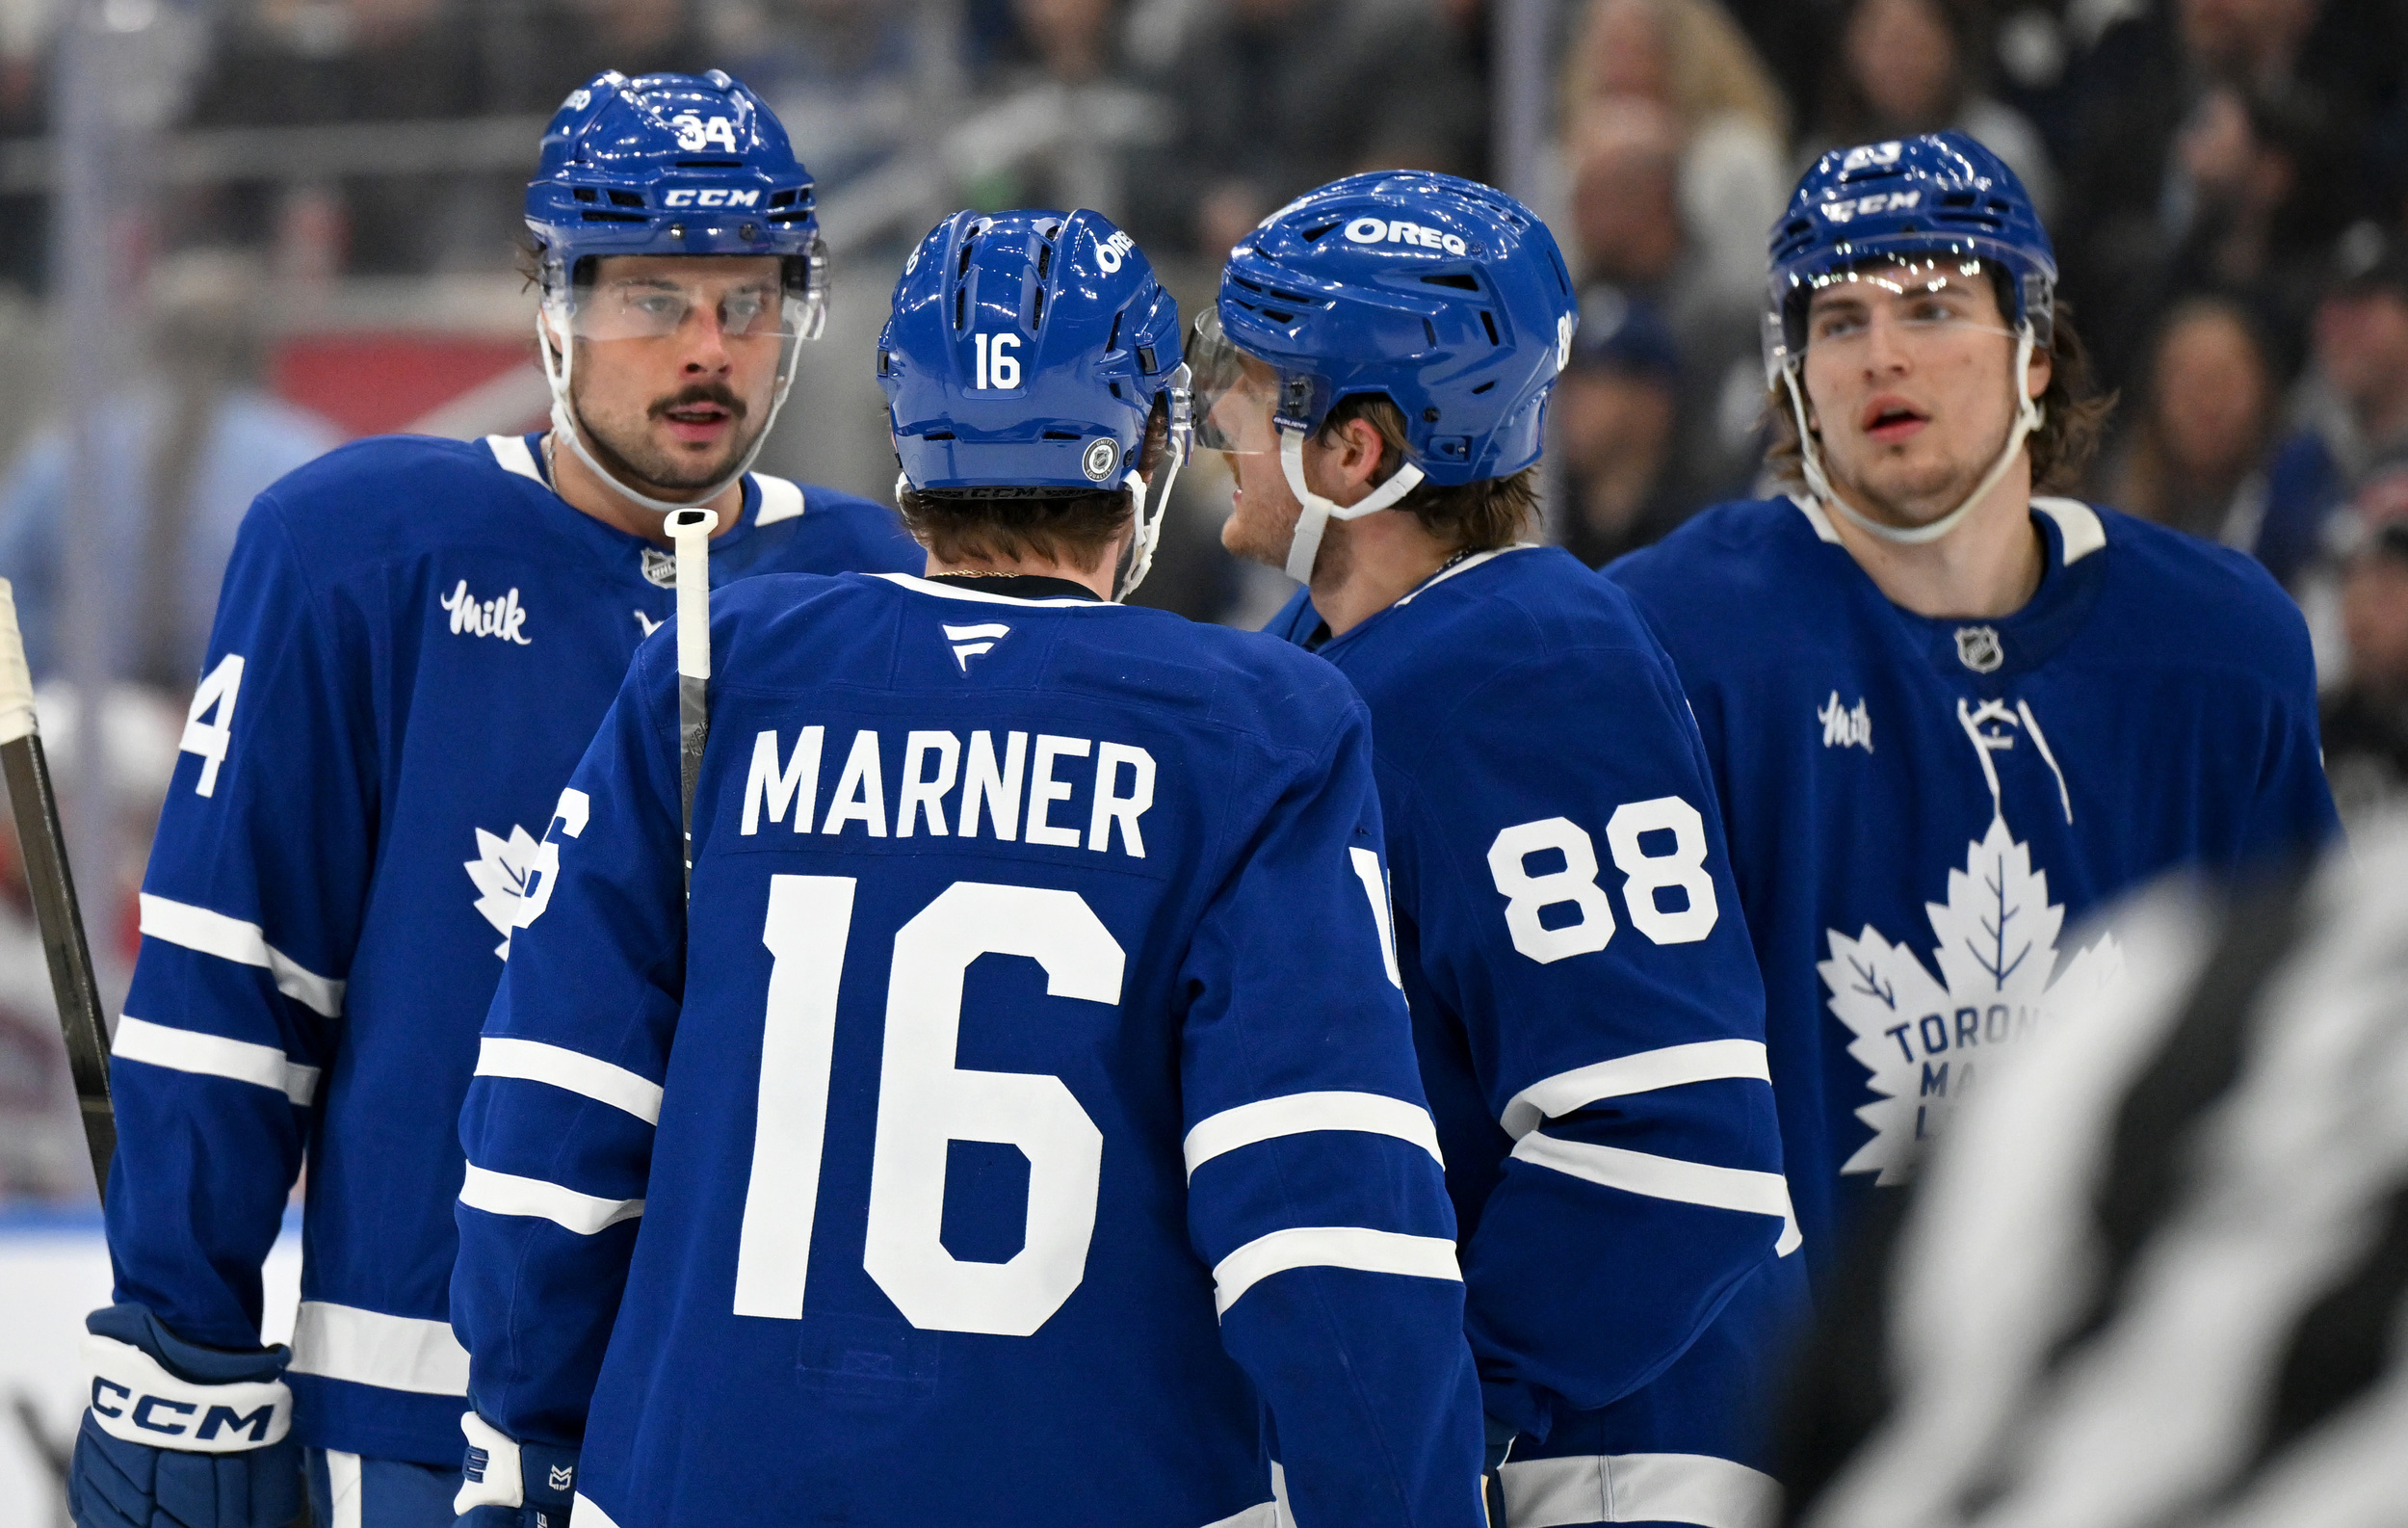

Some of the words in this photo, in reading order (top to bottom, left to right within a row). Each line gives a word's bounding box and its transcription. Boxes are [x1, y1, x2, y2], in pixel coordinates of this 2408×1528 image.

[672, 114, 737, 154] 34
[664, 189, 761, 207] CCM
[1820, 192, 1922, 223] CCM
[1345, 218, 1467, 256] OREO
[975, 333, 1022, 390] 16
[440, 579, 532, 645] Milk
[740, 724, 1157, 858] MARNER
[1486, 795, 1719, 964] 88
[732, 873, 1126, 1337] 16
[92, 1376, 276, 1442] CCM
